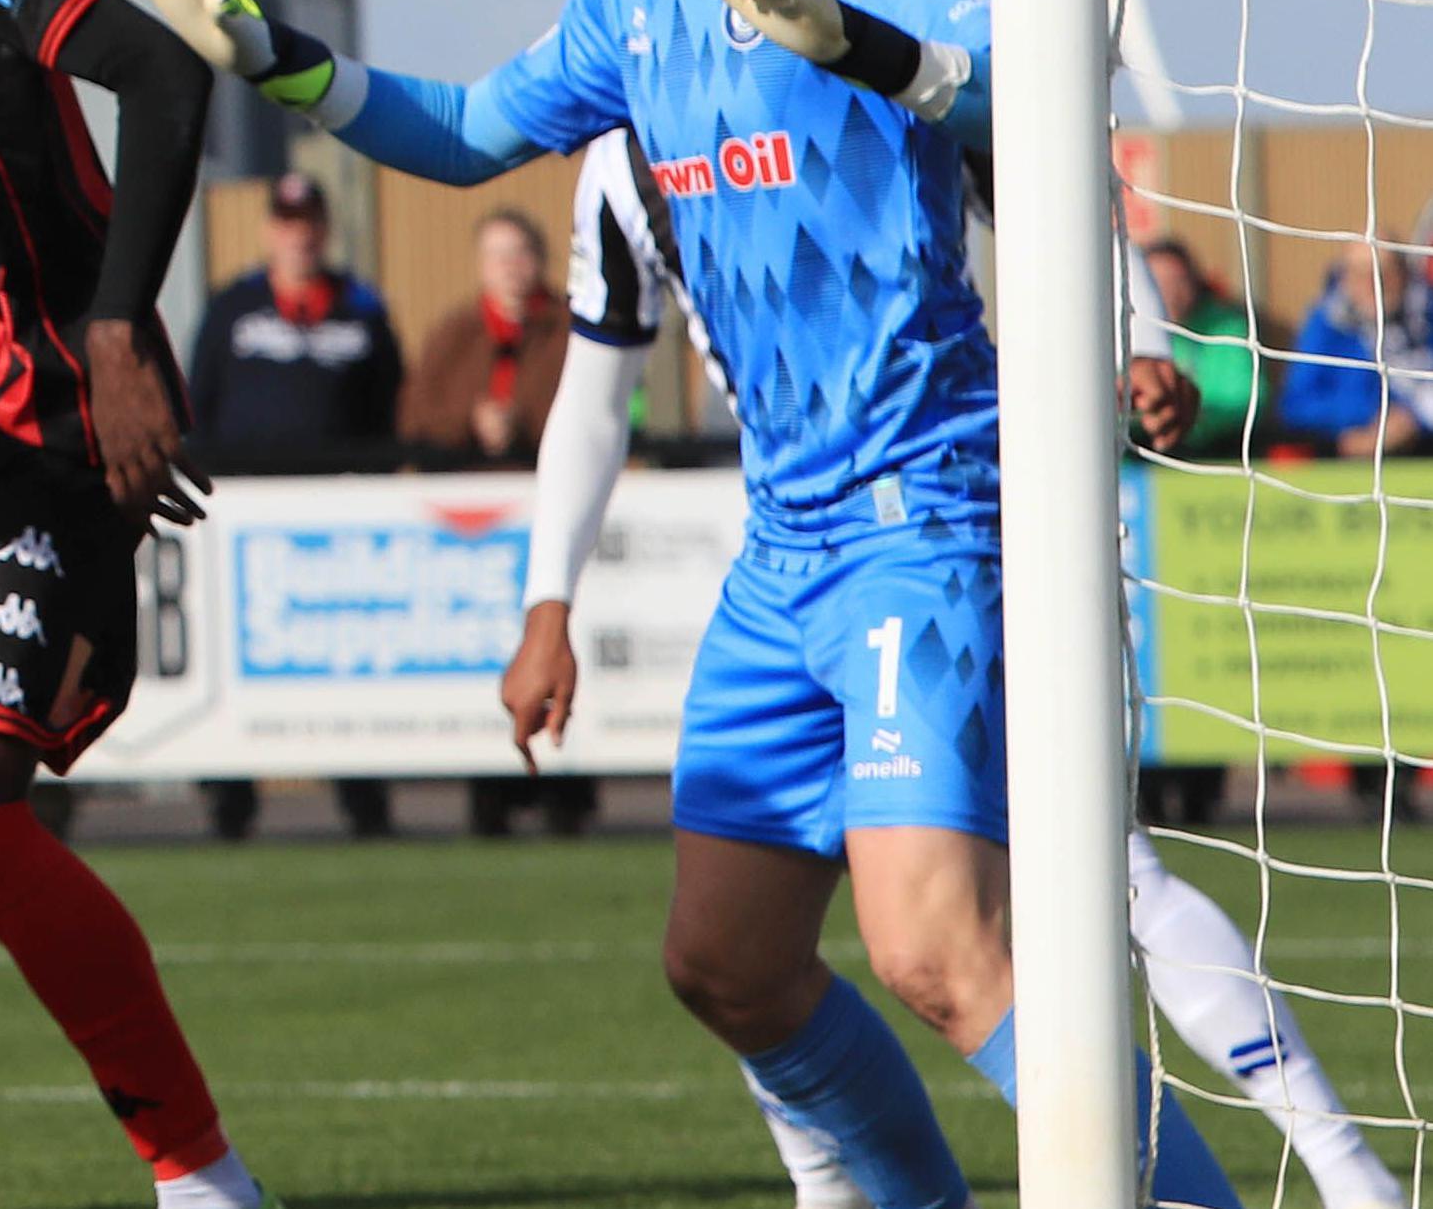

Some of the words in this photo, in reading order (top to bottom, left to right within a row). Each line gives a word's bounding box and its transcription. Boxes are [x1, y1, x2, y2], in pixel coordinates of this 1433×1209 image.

[719, 131, 796, 193] Oil
[867, 616, 903, 719] 1
[852, 754, 922, 781] oneills
